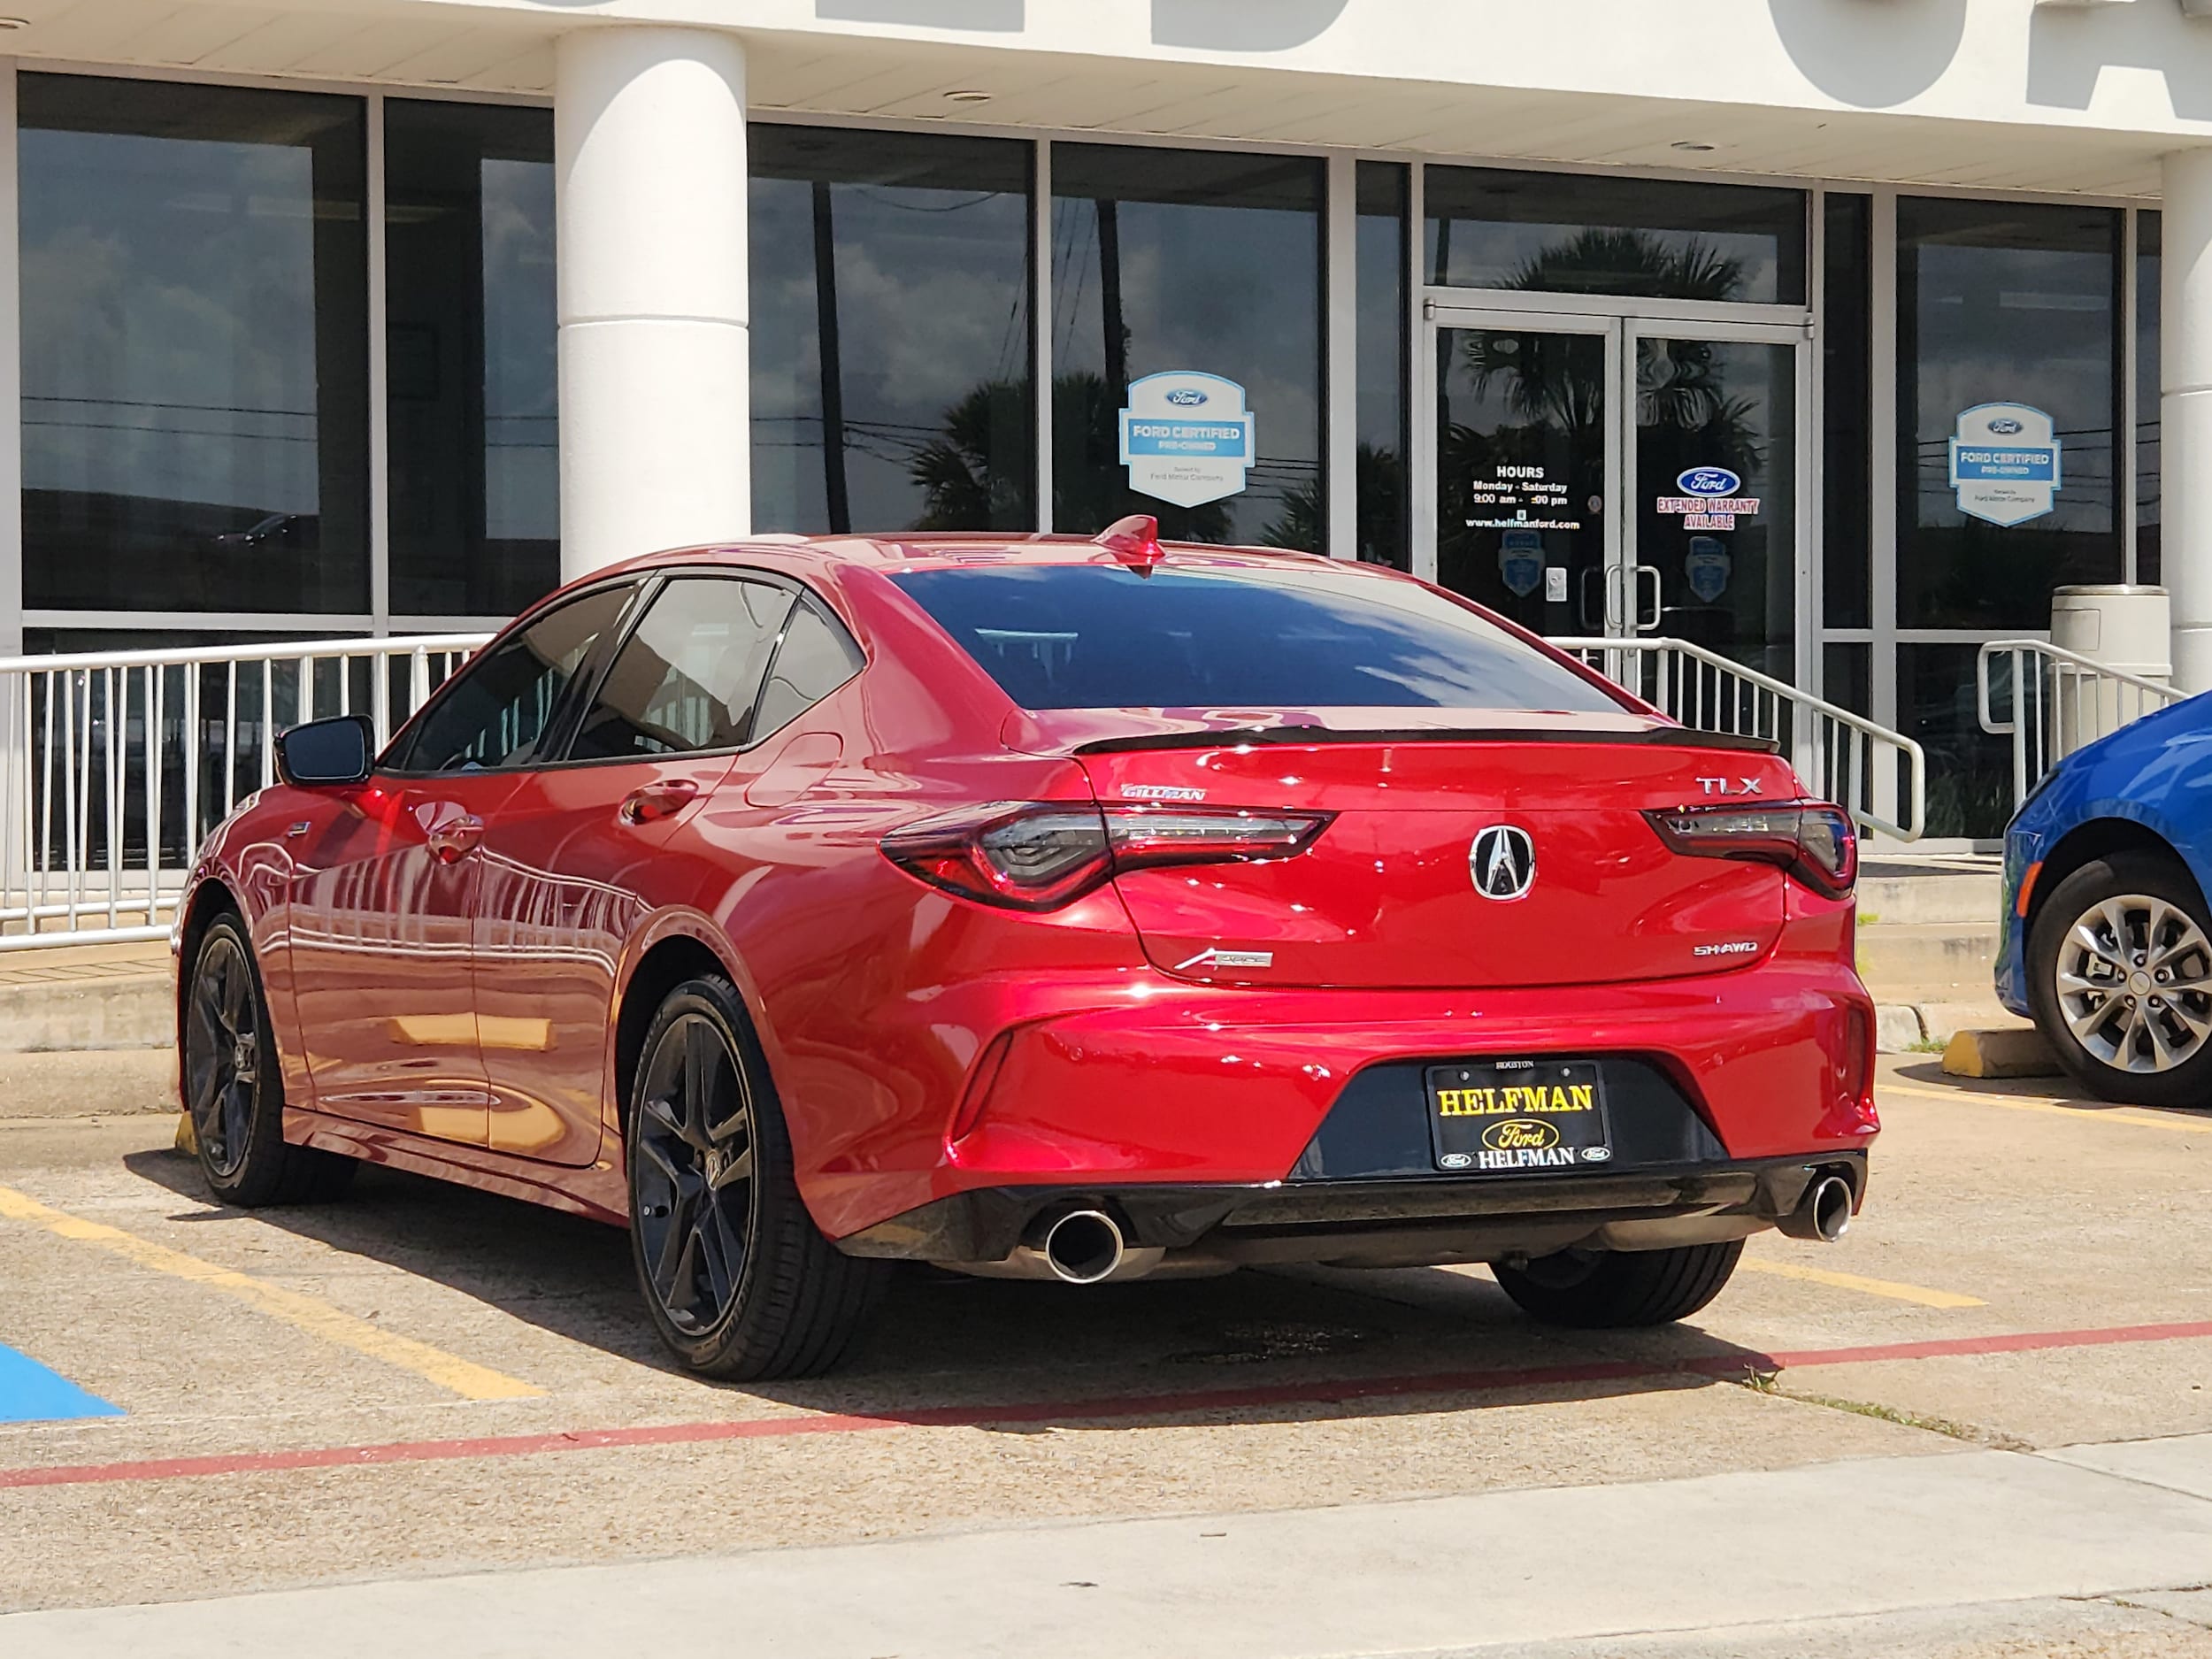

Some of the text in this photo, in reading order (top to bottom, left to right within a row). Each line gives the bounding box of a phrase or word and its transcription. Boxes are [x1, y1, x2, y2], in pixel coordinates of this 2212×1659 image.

[1172, 389, 1202, 404] Ford
[1133, 426, 1240, 440] FORD CERTIFIED
[1961, 452, 2049, 465] FORD CERTIFIED
[1496, 465, 1545, 479] HOURS
[1472, 480, 1514, 493] Monday
[1521, 481, 1568, 495] Saturday
[1690, 472, 1727, 491] Ford
[1551, 497, 1568, 507] pm
[1658, 498, 1759, 513] EXTENDED WARRANTY
[1684, 515, 1734, 529] AVAILABLE
[1120, 784, 1206, 801] GILLMAN
[1695, 777, 1763, 795] TLX
[1437, 1085, 1593, 1117] HELFMAN
[1498, 1123, 1545, 1148] Ford
[1479, 1147, 1576, 1169] HELFMAN
